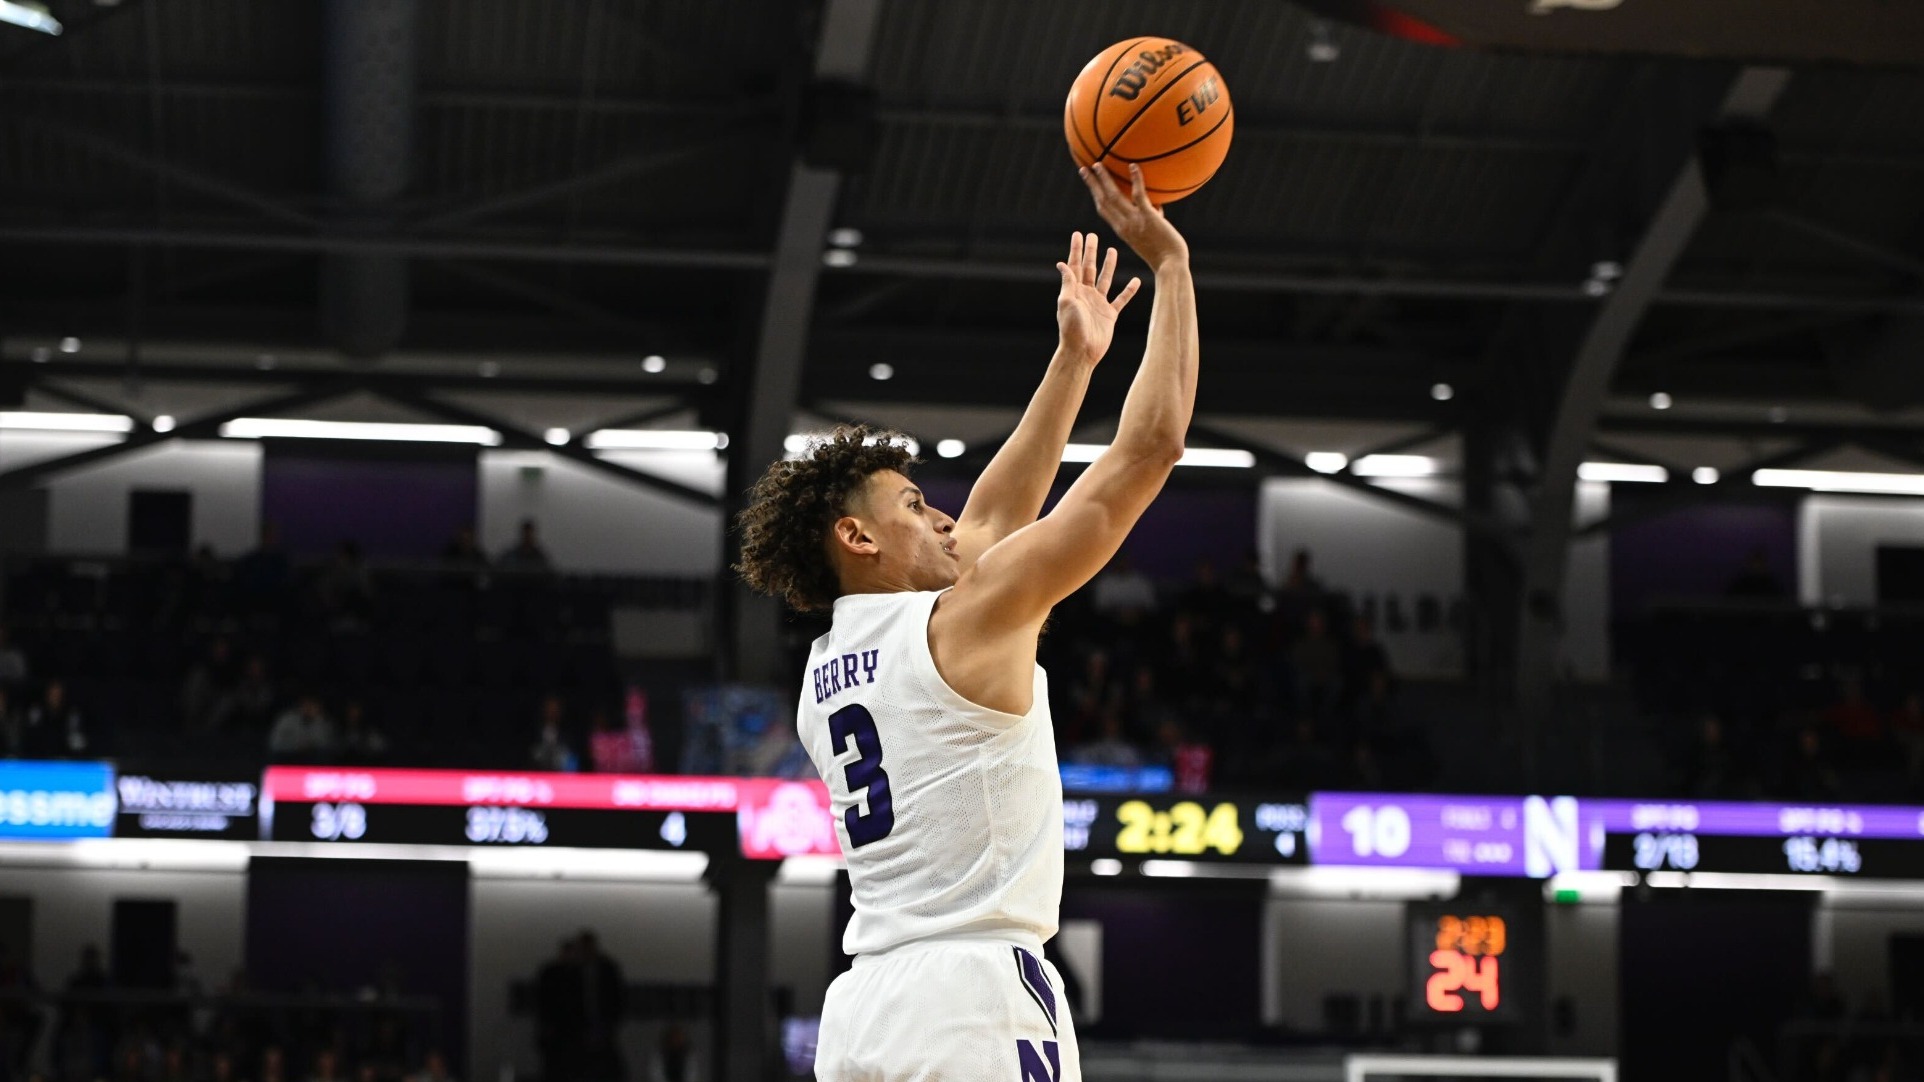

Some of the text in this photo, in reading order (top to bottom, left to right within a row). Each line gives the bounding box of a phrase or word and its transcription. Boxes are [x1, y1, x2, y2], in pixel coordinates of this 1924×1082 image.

[813, 649, 879, 704] BERRY
[828, 703, 894, 849] 3
[311, 802, 366, 840] 3/8
[465, 806, 548, 843] 37.5%
[660, 811, 686, 846] 4
[1116, 800, 1243, 855] 2:24
[1340, 804, 1411, 858] 10
[1522, 794, 1579, 878] N
[1427, 950, 1499, 1011] 24
[1016, 1039, 1061, 1082] N
